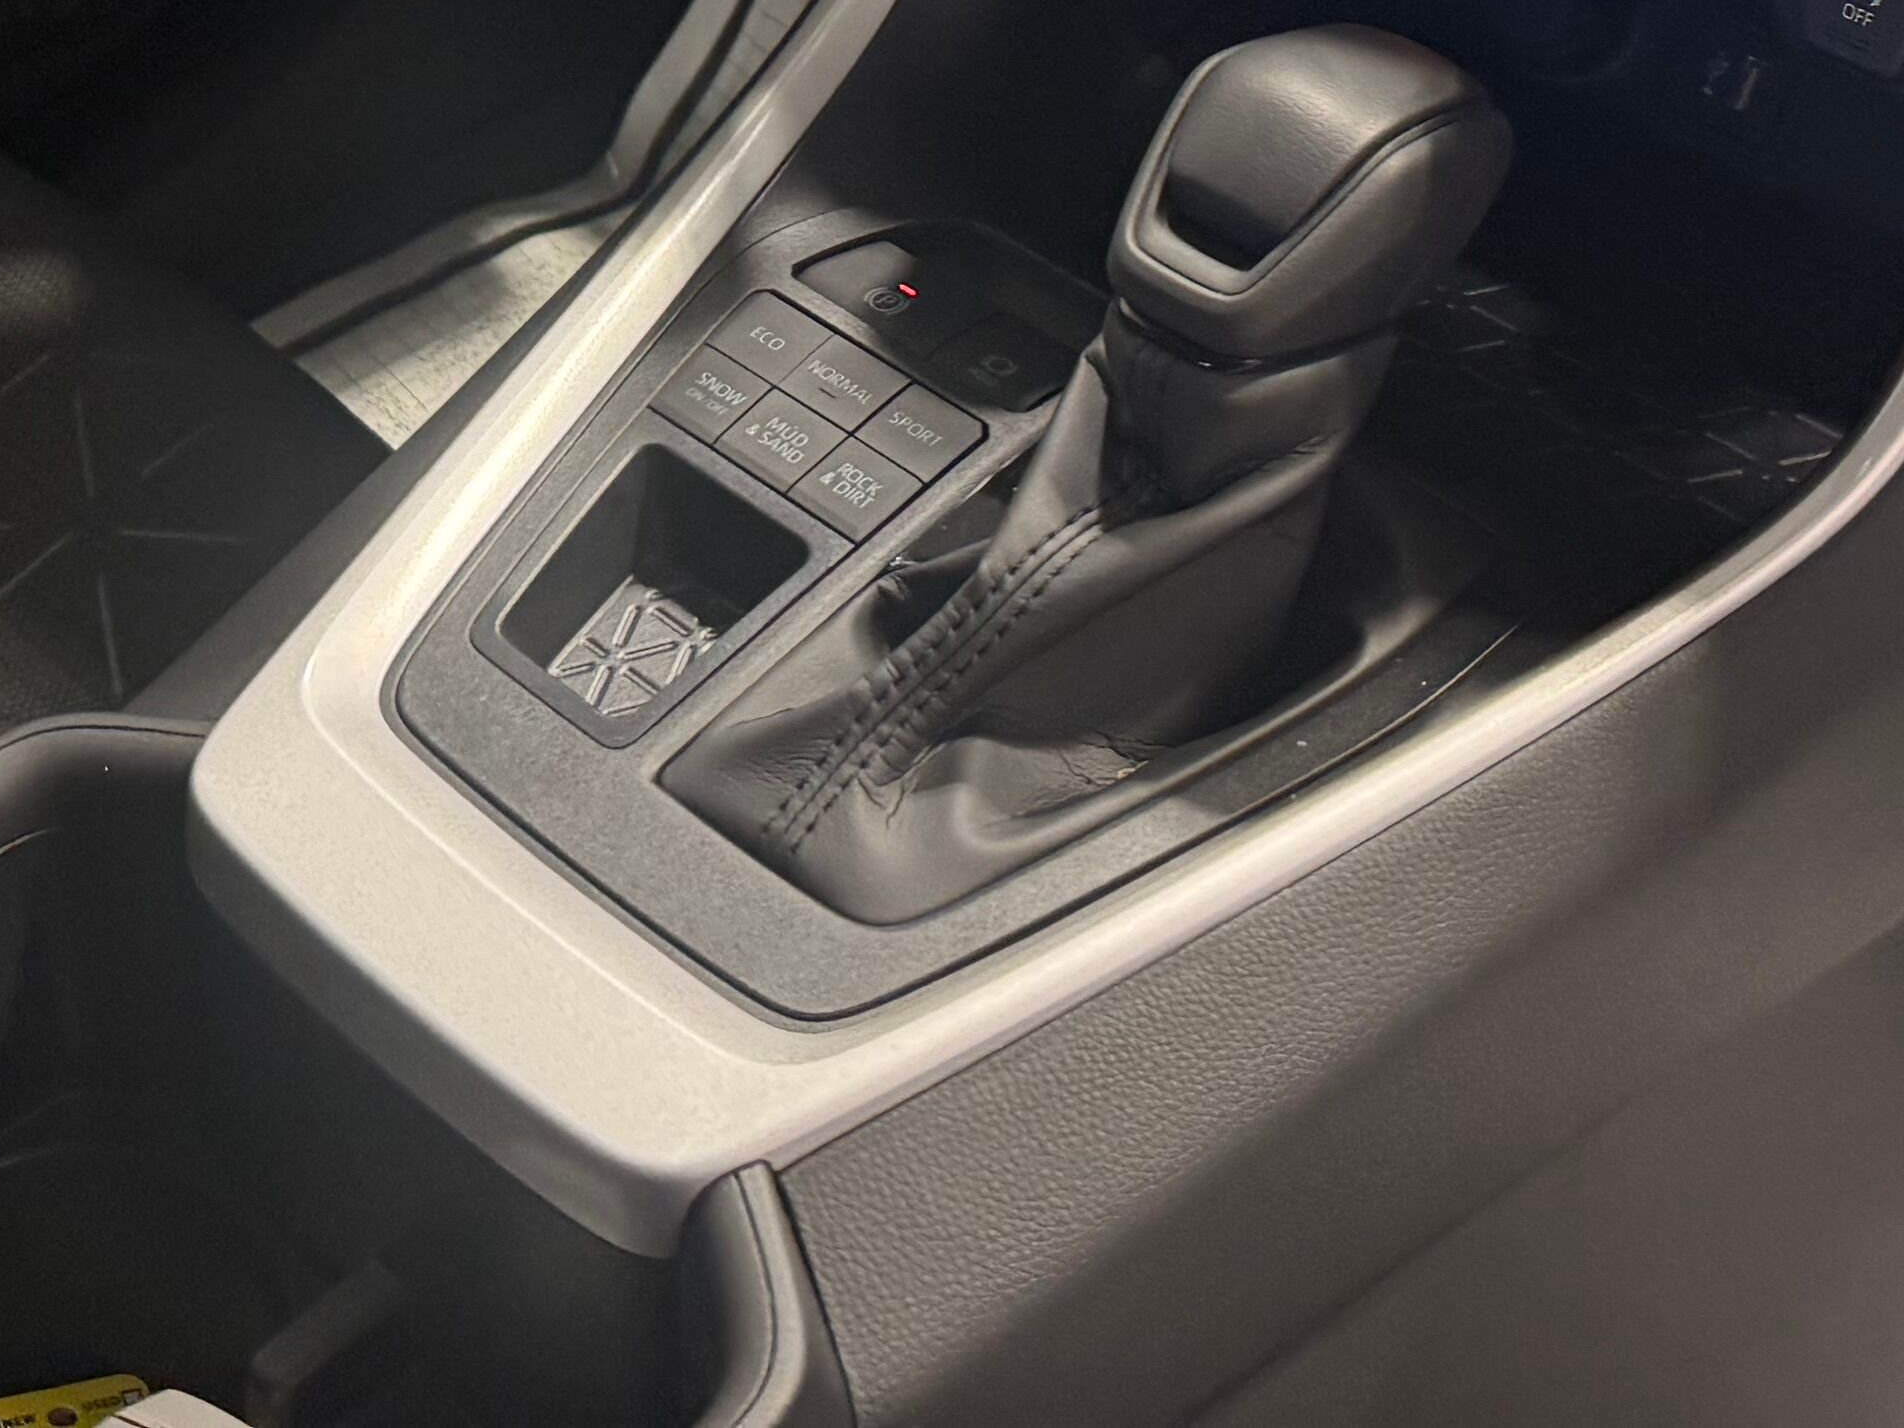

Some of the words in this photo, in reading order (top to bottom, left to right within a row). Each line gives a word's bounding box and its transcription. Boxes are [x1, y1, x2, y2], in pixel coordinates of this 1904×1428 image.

[1842, 3, 1875, 27] OFF
[750, 326, 786, 352] ECO
[696, 372, 748, 406] SNOW
[807, 359, 874, 405] NORMAL
[765, 416, 809, 448] MUD
[888, 411, 944, 448] SPORT
[756, 431, 805, 464] SAND
[831, 480, 875, 509] DIRT
[836, 462, 884, 497] ROCK
